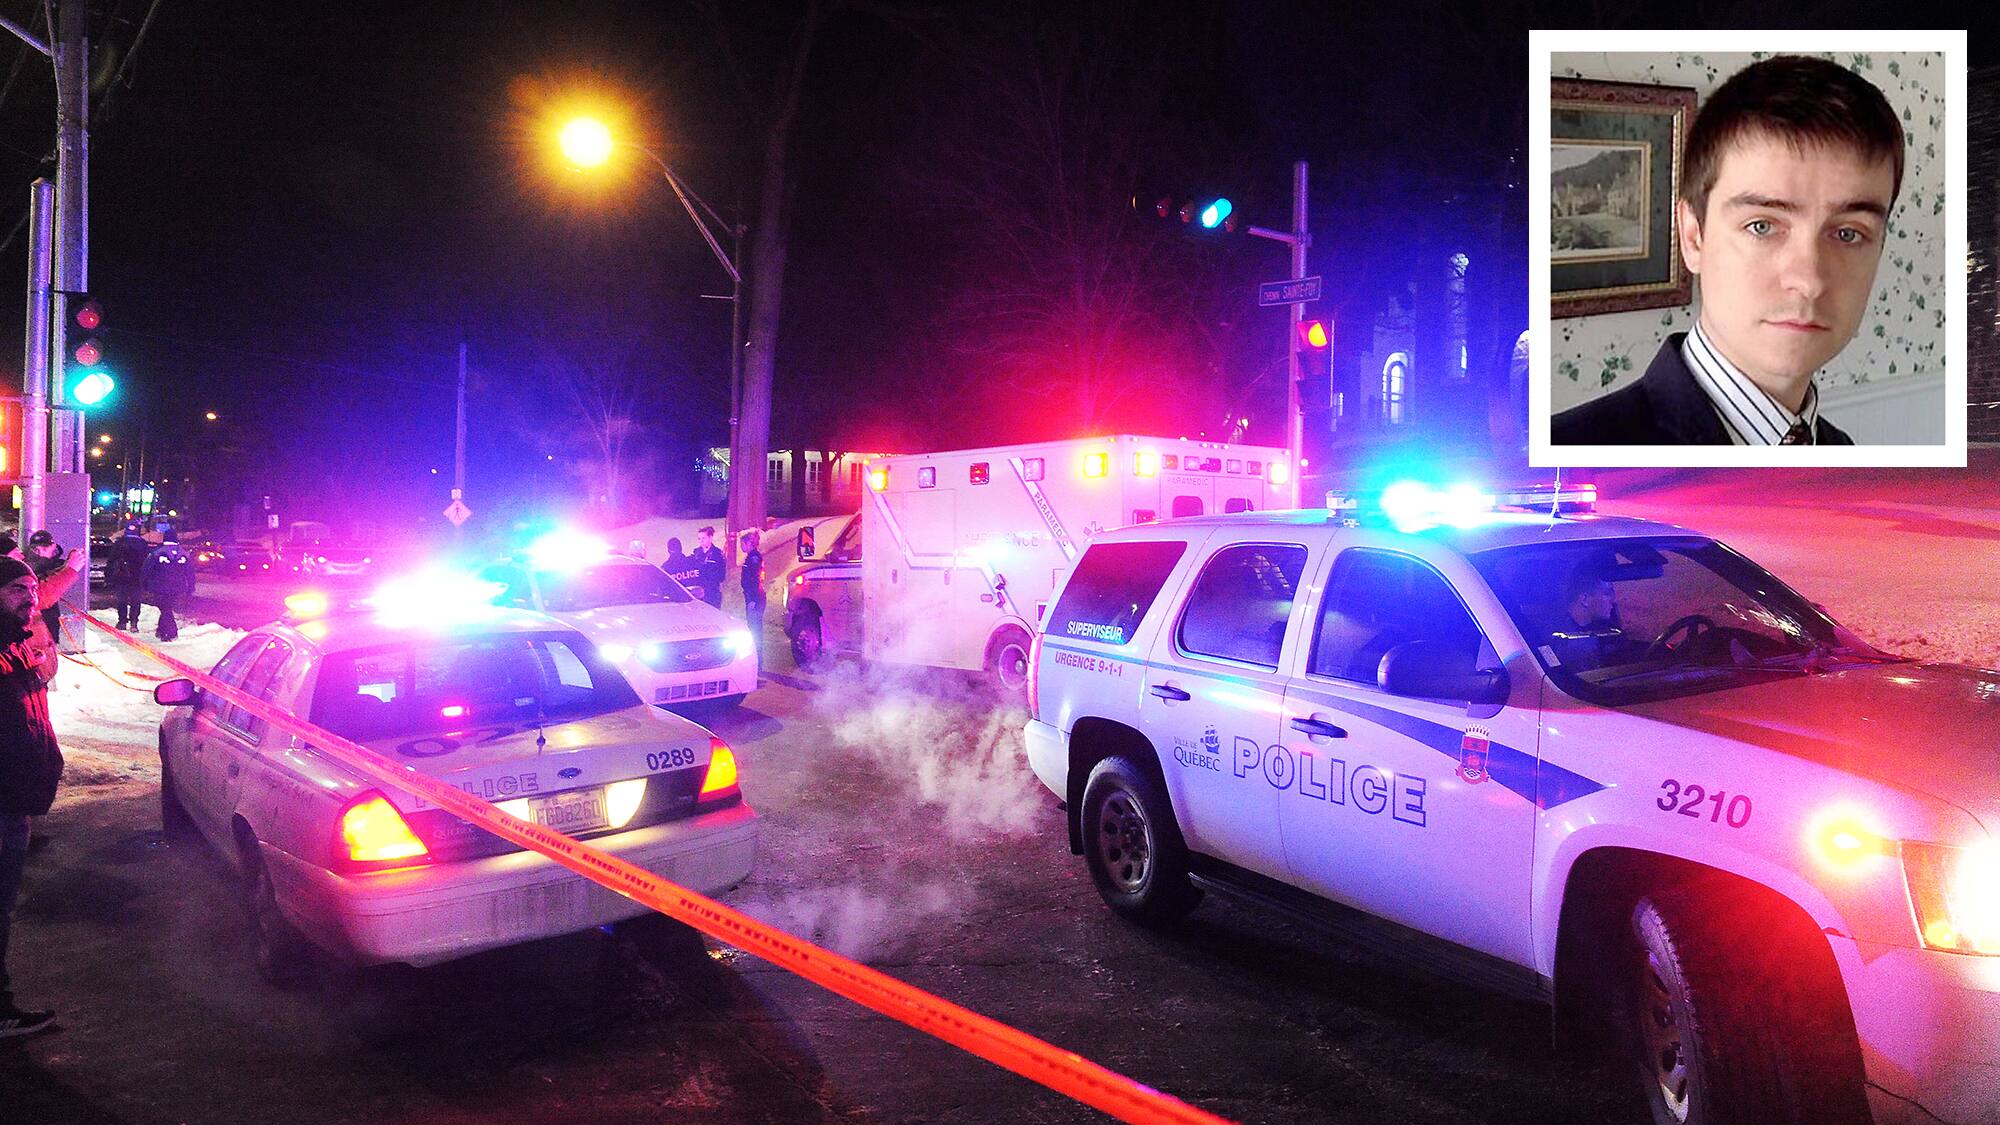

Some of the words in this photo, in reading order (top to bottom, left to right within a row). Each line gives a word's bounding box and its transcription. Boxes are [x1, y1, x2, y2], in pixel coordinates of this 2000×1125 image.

[1066, 620, 1124, 641] SUPERVISEUR
[1055, 651, 1096, 672] URGENCE
[646, 746, 696, 771] 0289
[1173, 745, 1221, 773] QUÉBEC
[1233, 735, 1427, 828] POLICE
[1656, 778, 1753, 829] 3210
